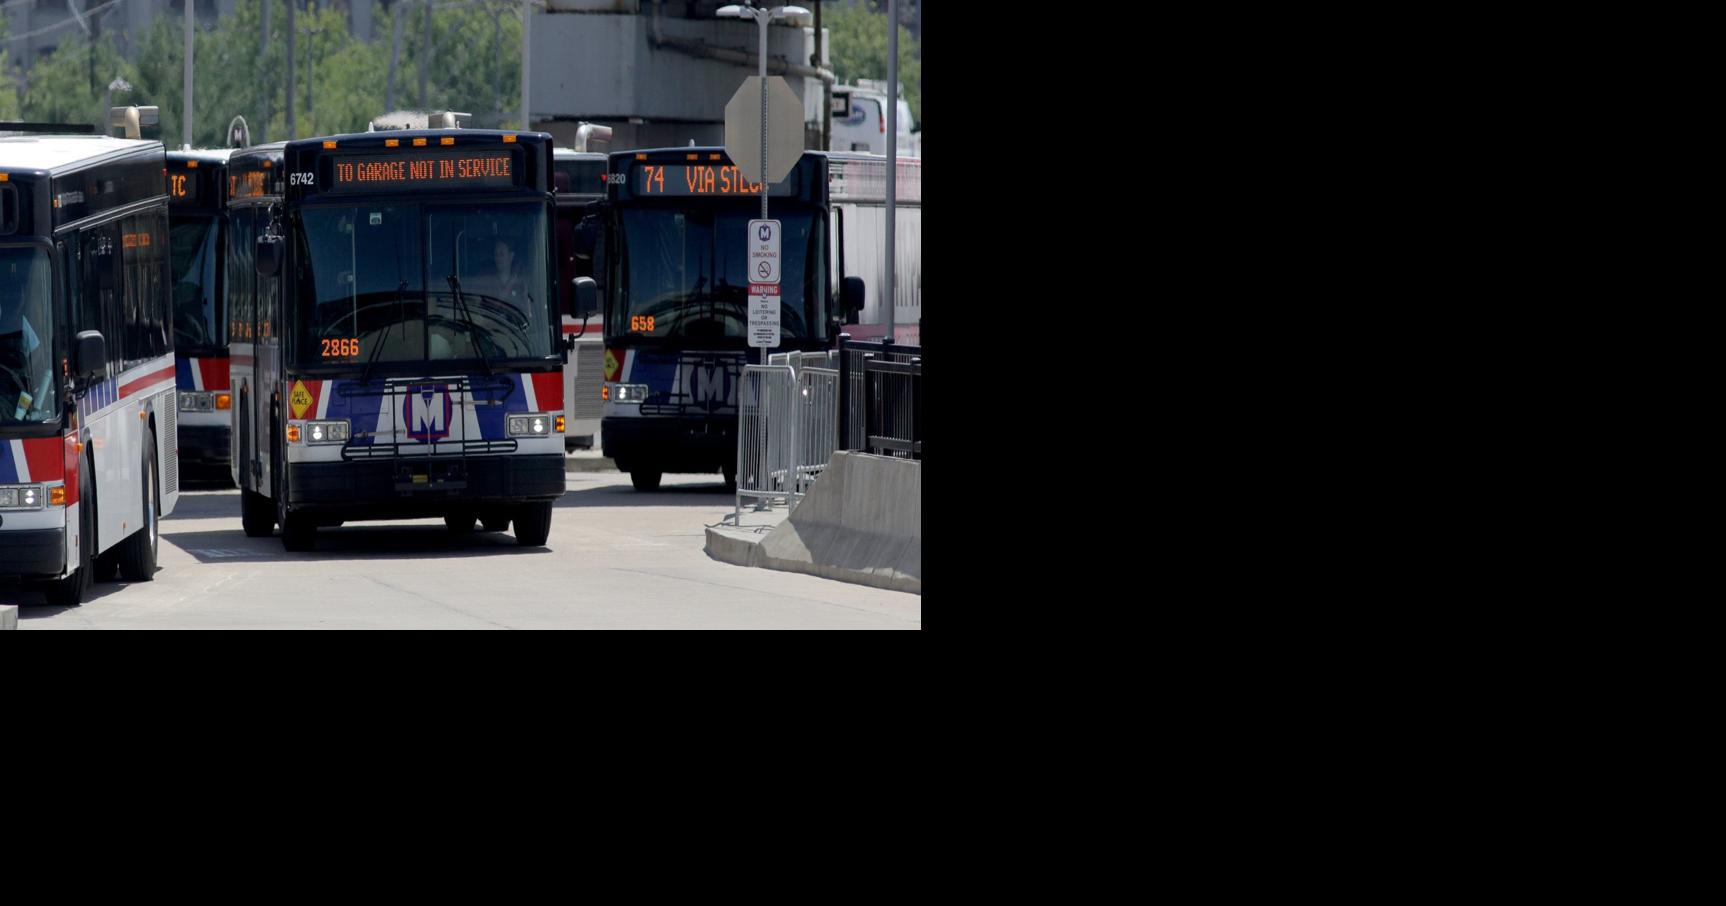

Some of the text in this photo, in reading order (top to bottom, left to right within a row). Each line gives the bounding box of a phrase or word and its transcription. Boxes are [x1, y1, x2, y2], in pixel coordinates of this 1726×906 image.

[290, 172, 314, 185] 6742
[338, 157, 510, 182] TO GARAGE NOT IN SERVICE
[644, 166, 665, 193] 74
[686, 166, 715, 193] VIA
[171, 175, 186, 197] TC
[751, 285, 778, 294] WARNING
[631, 315, 655, 332] 658
[321, 338, 360, 357] 2866
[697, 364, 724, 403] M
[411, 391, 444, 432] M
